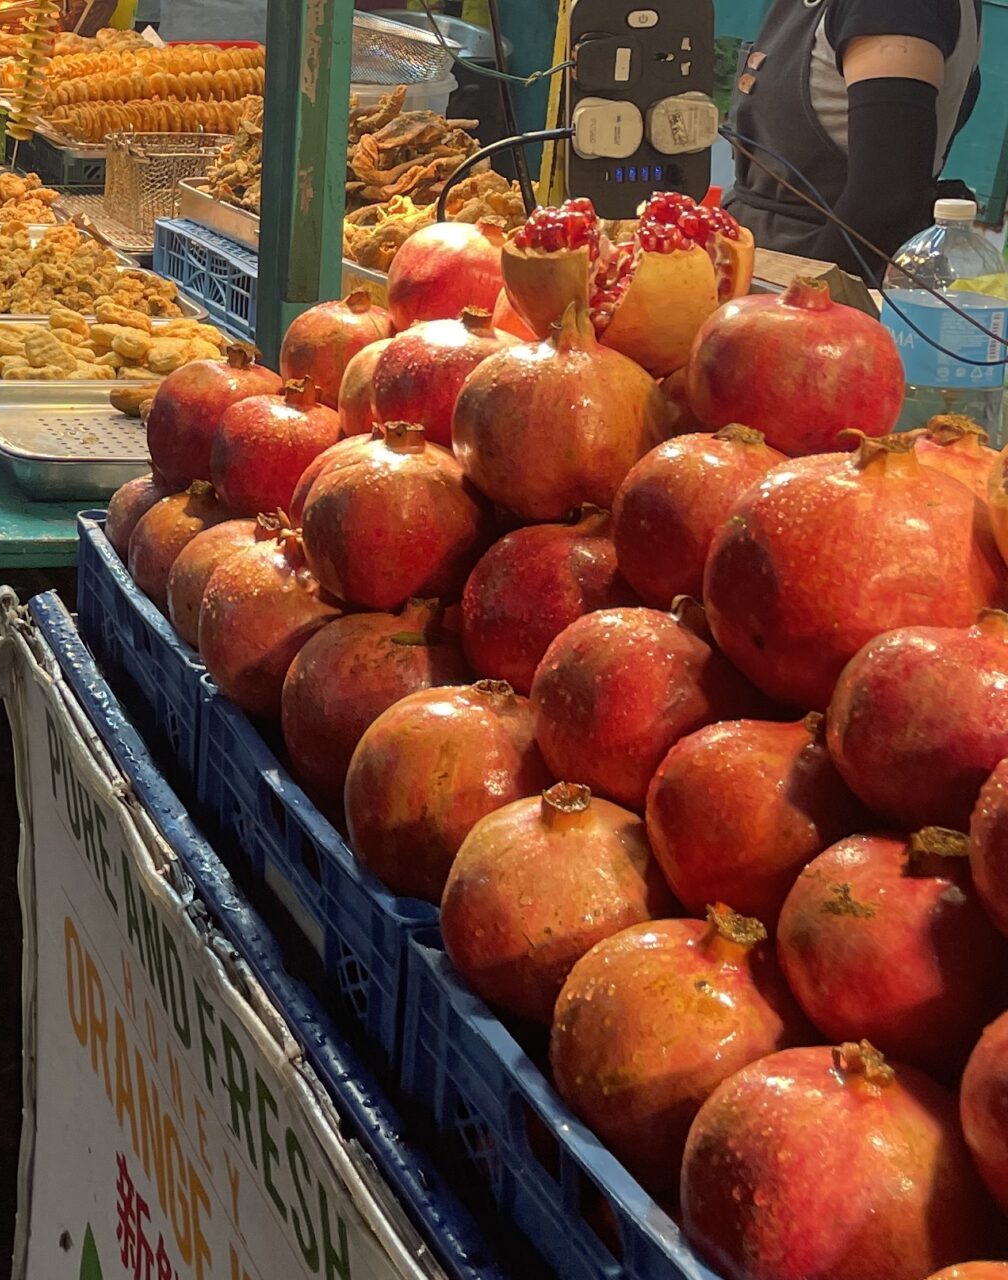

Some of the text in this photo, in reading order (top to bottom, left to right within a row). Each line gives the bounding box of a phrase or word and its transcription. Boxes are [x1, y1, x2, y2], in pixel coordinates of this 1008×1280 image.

[44, 706, 352, 1280] PURE AND FRESH
